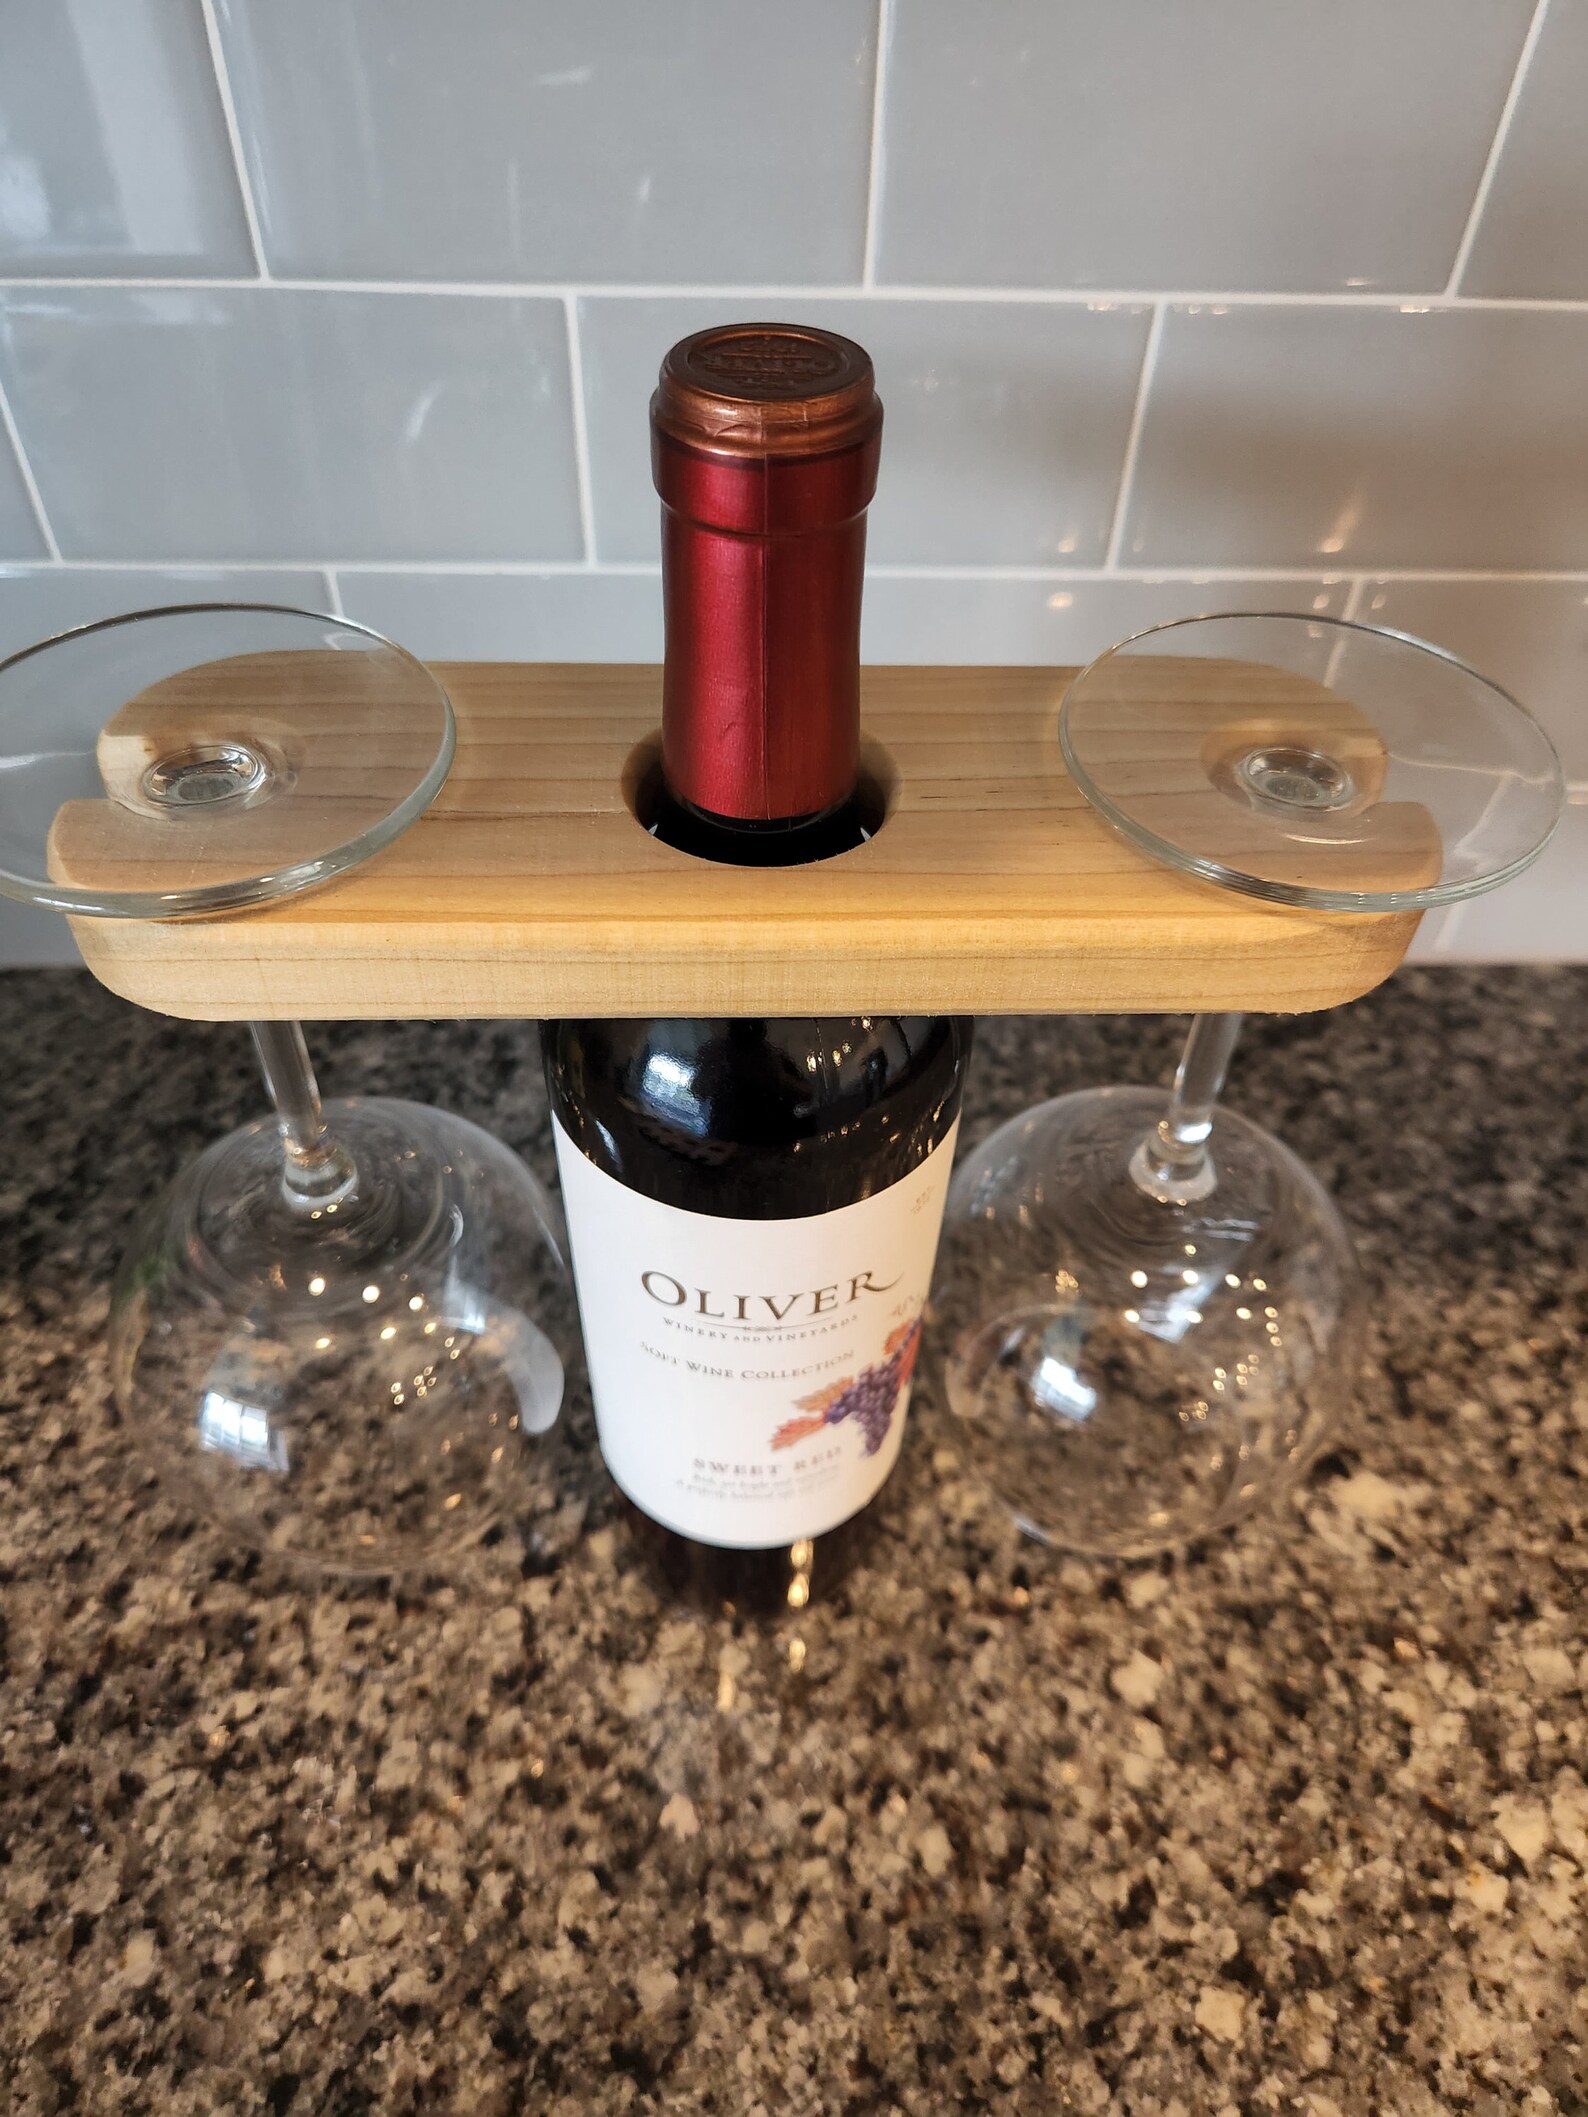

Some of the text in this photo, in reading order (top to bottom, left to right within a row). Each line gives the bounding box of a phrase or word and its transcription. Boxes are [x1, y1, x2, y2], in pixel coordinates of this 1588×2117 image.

[641, 1270, 905, 1321] OLIVER
[662, 1316, 728, 1341] WINERY
[765, 1313, 859, 1343] VINEYARDS
[640, 1341, 856, 1381] SOFT WINE COLLECTION
[692, 1457, 782, 1475] SWEET
